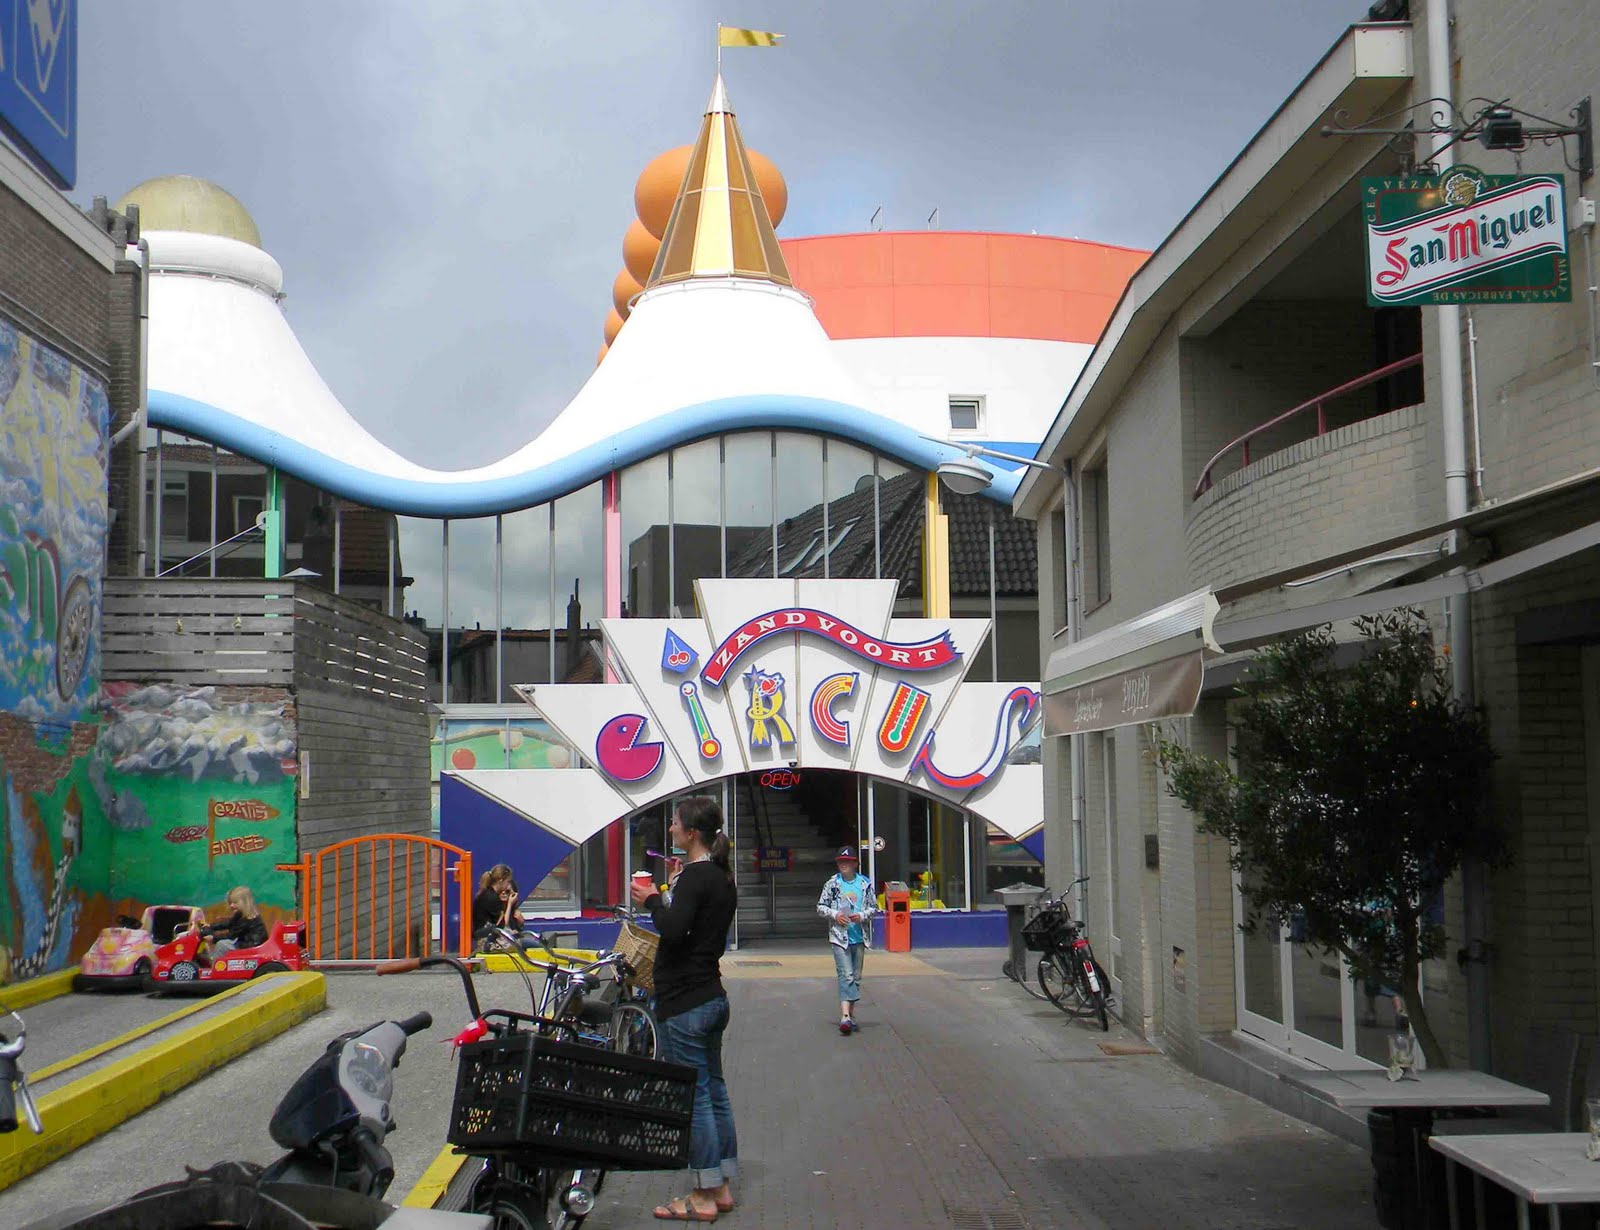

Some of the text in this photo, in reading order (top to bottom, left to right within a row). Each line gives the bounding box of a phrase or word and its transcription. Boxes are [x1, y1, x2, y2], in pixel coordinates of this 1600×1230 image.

[1375, 194, 1556, 287] San Miguel
[1432, 291, 1450, 301] DE
[714, 611, 939, 669] ZANDVOORT
[595, 663, 1042, 790] CIRCUS
[760, 772, 801, 787] OPEN
[213, 801, 269, 821] GRATIS
[212, 835, 265, 856] ENTREE
